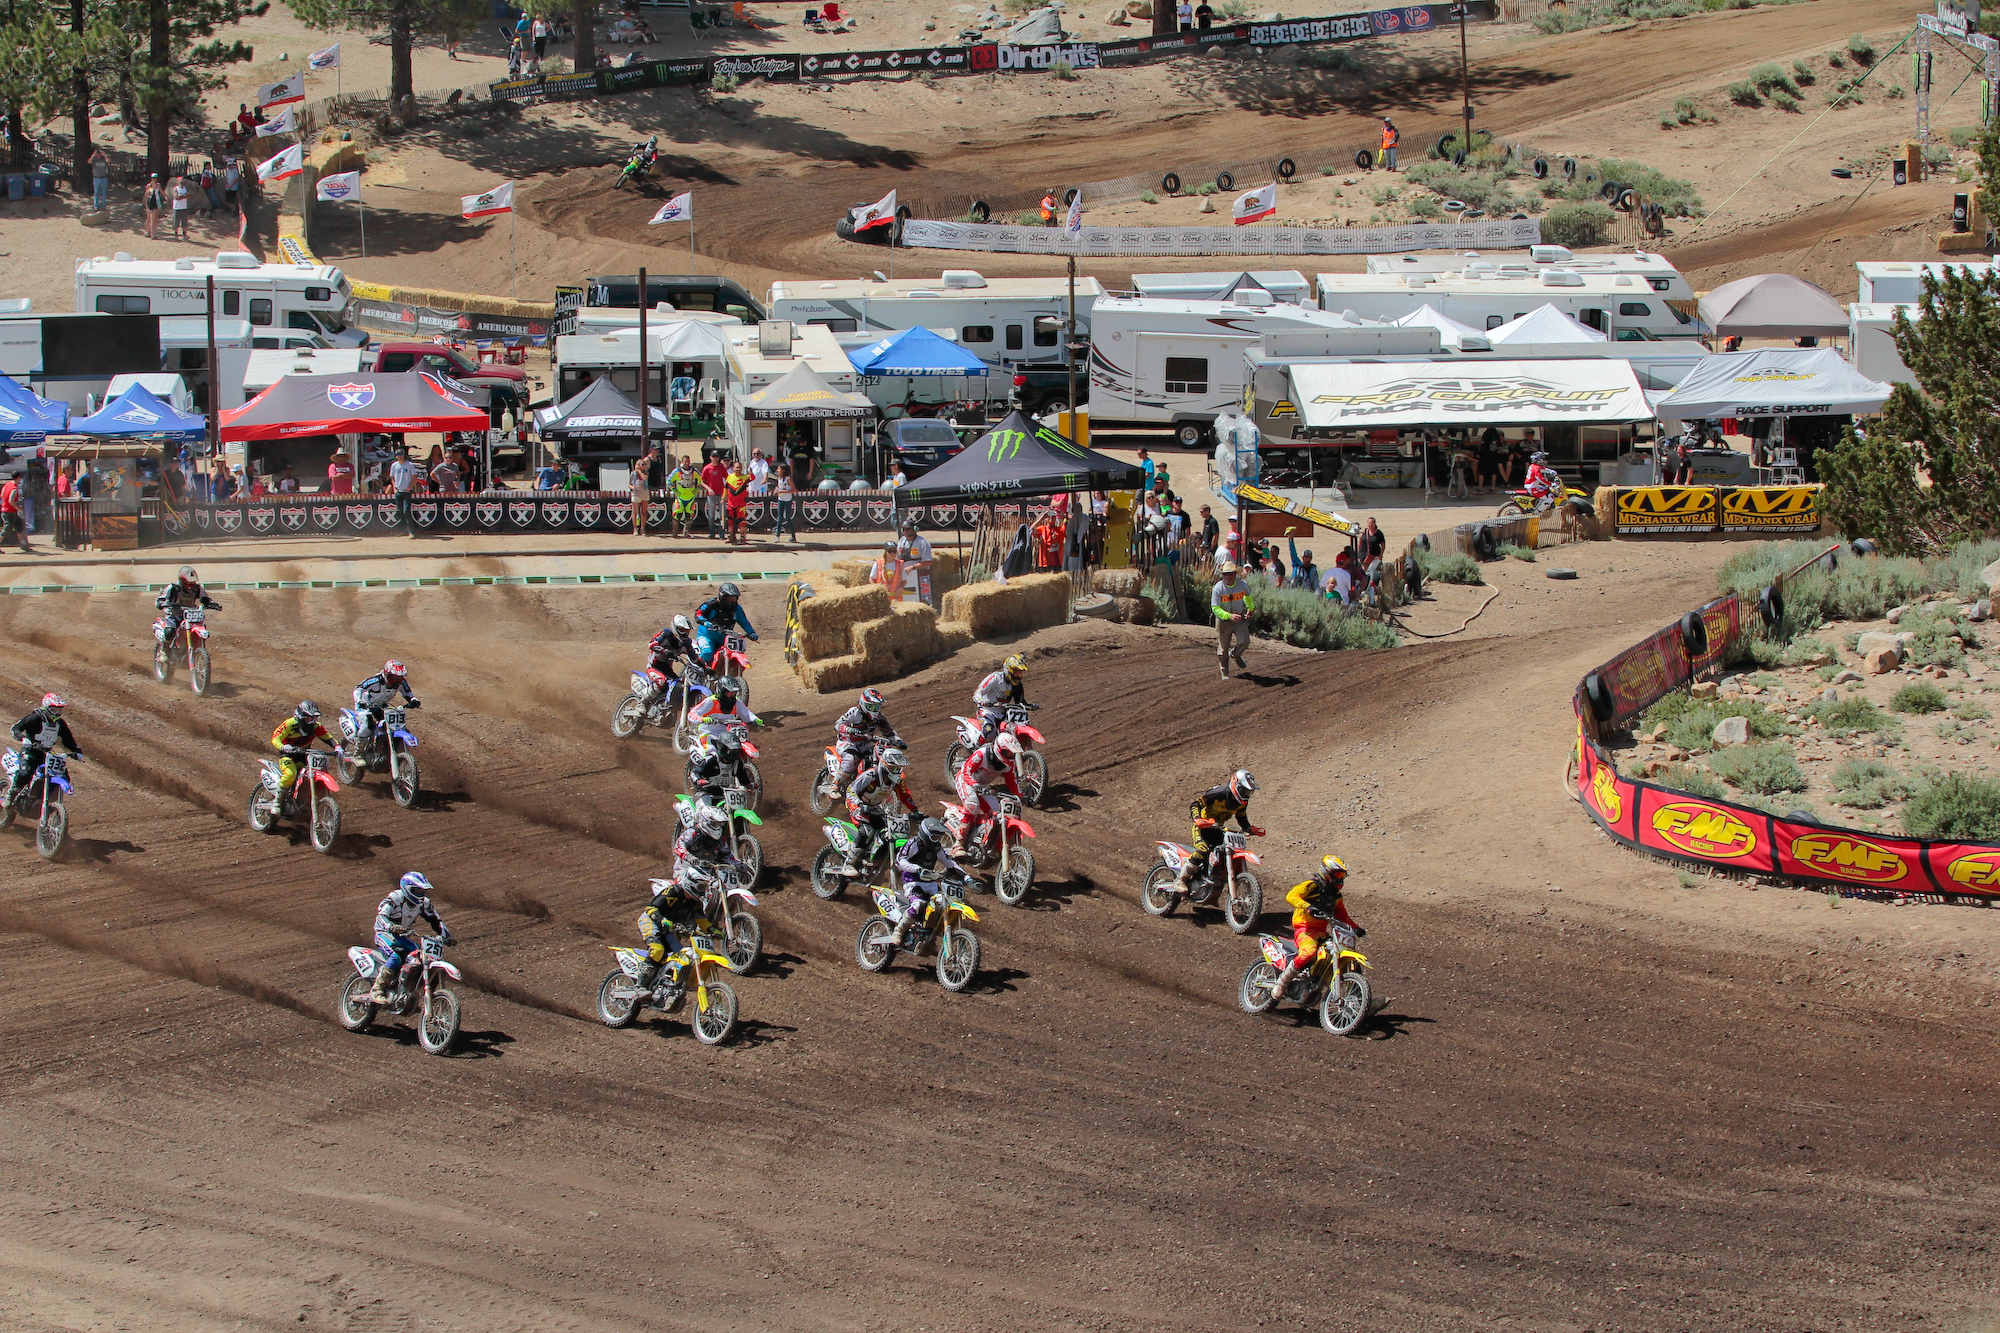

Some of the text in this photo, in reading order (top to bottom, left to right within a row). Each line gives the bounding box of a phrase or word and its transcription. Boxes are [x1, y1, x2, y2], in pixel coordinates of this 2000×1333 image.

[1374, 11, 1391, 29] VP
[1404, 7, 1421, 26] VP
[1200, 32, 1236, 42] AMERICORE
[1152, 40, 1185, 49] AMERICORE
[1102, 47, 1139, 57] AMERICORE
[668, 63, 705, 73] MONSTER
[751, 57, 795, 77] Designs
[562, 71, 596, 81] CIRCUIT
[613, 69, 645, 81] MONSTER
[909, 226, 928, 236] Ford
[939, 228, 958, 238] Ford
[969, 230, 988, 239] Ford
[1425, 230, 1444, 239] Ford
[1454, 230, 1474, 238] Ford
[1485, 228, 1504, 237] Ford
[1515, 226, 1534, 235] Ford
[1000, 232, 1018, 241] Ford
[1030, 233, 1048, 242] Ford
[1092, 234, 1110, 242] Ford
[1121, 234, 1140, 243] Ford
[1152, 234, 1170, 243] Ford
[1182, 234, 1200, 242] Ford
[1213, 234, 1231, 242] Ford
[1243, 233, 1261, 242] Ford
[1275, 234, 1293, 242] Ford
[1304, 234, 1323, 243] Ford
[1334, 234, 1352, 243] Ford
[1364, 234, 1382, 242] Ford
[1395, 232, 1413, 241] Ford
[160, 289, 195, 299] TIOGA
[360, 307, 402, 321] AMERICORE
[418, 315, 459, 329] AMERICORE
[477, 322, 529, 334] AMERICORE
[885, 366, 966, 376] TOYO TIRES
[1733, 372, 1817, 383] PRO CIRCUIT
[341, 392, 364, 406] X
[1311, 387, 1629, 405] PRO CIRCUIT
[754, 408, 865, 418] THE BEST SUSPENSION. PERIOD.
[1340, 399, 1609, 417] RACE SUPPORT
[1735, 403, 1832, 415] RACE SUPPORT
[280, 425, 329, 434] SUBSCRIBE!
[960, 478, 1022, 493] MONSTER
[970, 491, 1013, 499] ENERGY
[320, 514, 333, 525] X
[353, 512, 366, 524] X
[385, 511, 397, 522] X
[418, 510, 431, 522] X
[451, 510, 464, 522] X
[483, 510, 496, 522] X
[516, 510, 528, 522] X
[549, 510, 561, 522] X
[582, 510, 594, 522] X
[614, 510, 627, 522] X
[647, 510, 660, 522] X
[746, 509, 757, 520] X
[810, 508, 821, 520] X
[842, 508, 854, 520] X
[873, 508, 885, 520] X
[937, 511, 950, 523] X
[1618, 511, 1716, 524] MECHANIX WEAR
[1723, 512, 1818, 524] MECHANIX WEAR
[222, 517, 236, 528] X
[254, 516, 268, 527] X
[287, 515, 300, 527] X
[1653, 806, 1752, 846] FMF
[1690, 839, 1714, 852] RACING
[1792, 838, 1900, 872] FMF
[1840, 866, 1866, 878] RACING
[946, 885, 963, 899] 66
[879, 899, 895, 913] 66
